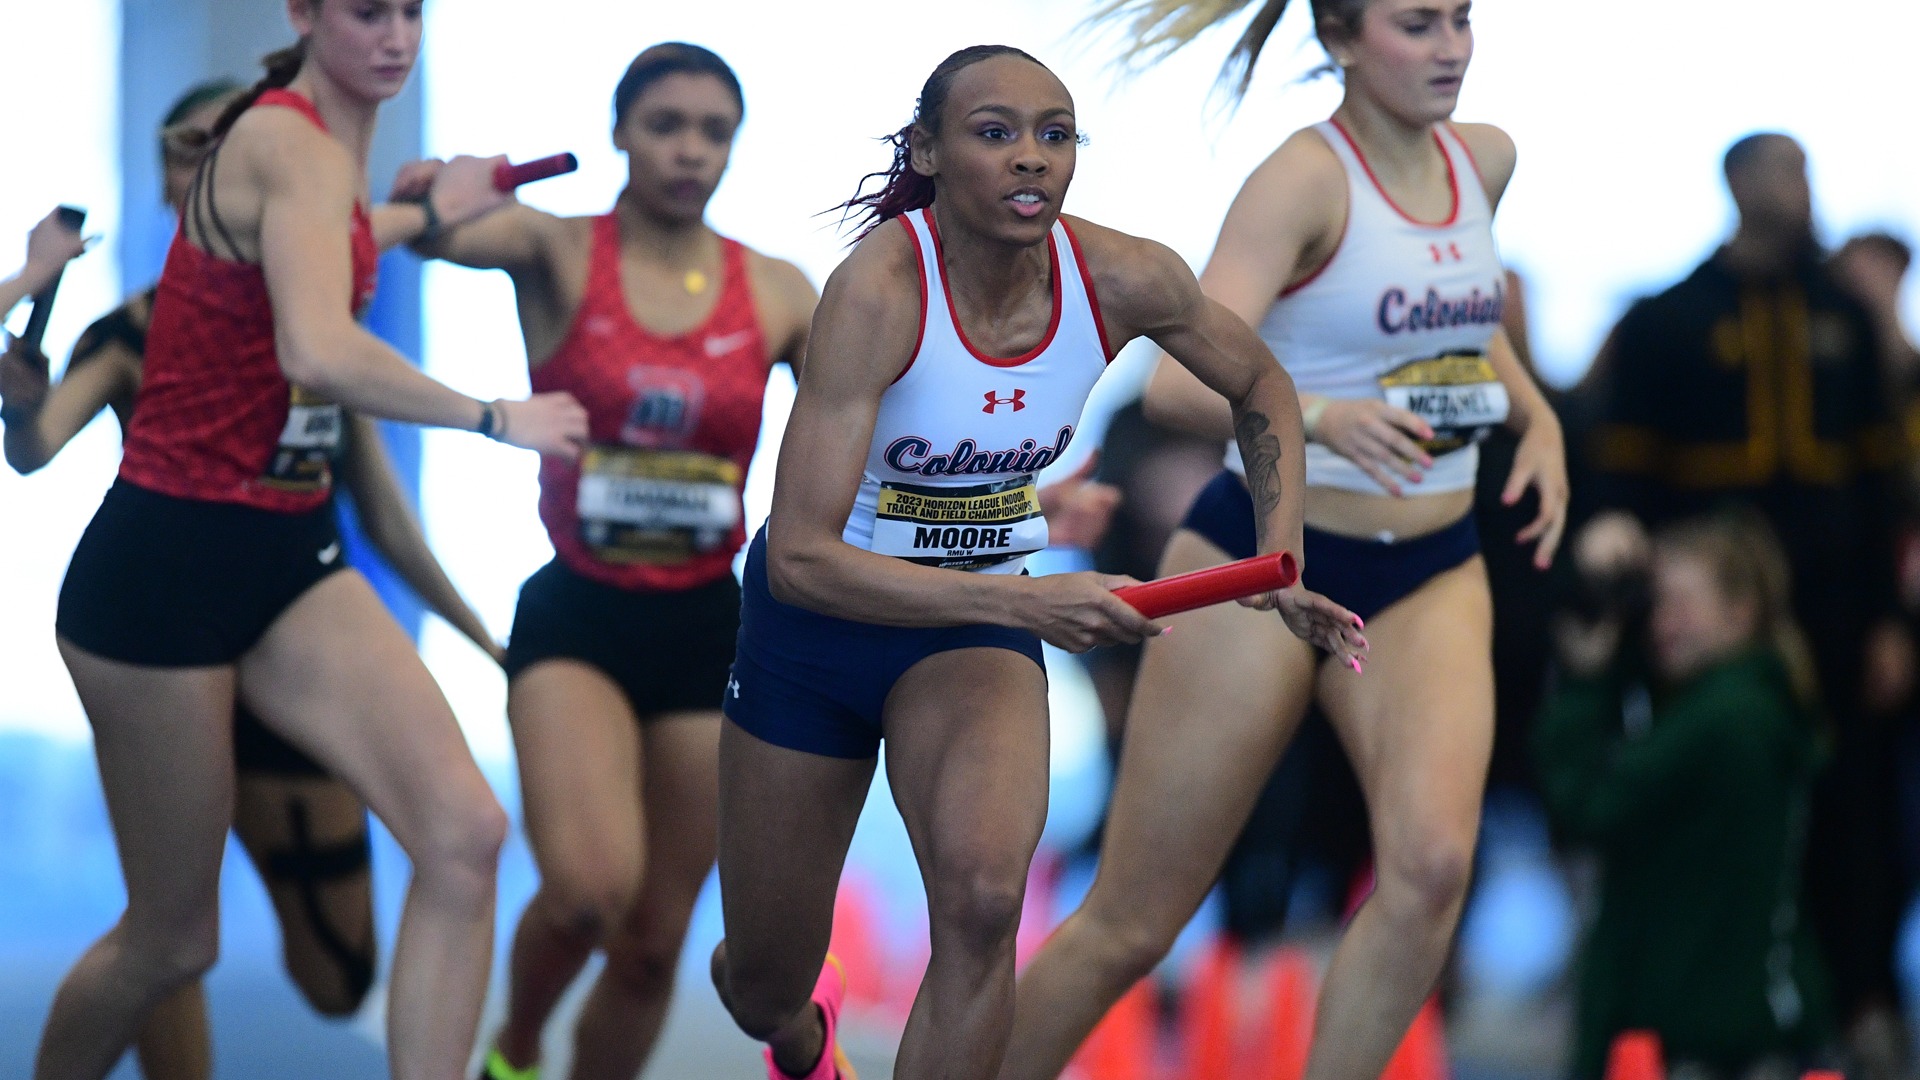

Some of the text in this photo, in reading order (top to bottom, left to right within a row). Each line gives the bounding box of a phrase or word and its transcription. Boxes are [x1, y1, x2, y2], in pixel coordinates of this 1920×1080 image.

[886, 500, 1033, 519] TRACK AND FIELD CHAMPIONSHIPS
[896, 490, 1026, 510] 2023 HORIZON LEAGUE INDOOR
[913, 527, 1013, 549] MOORE
